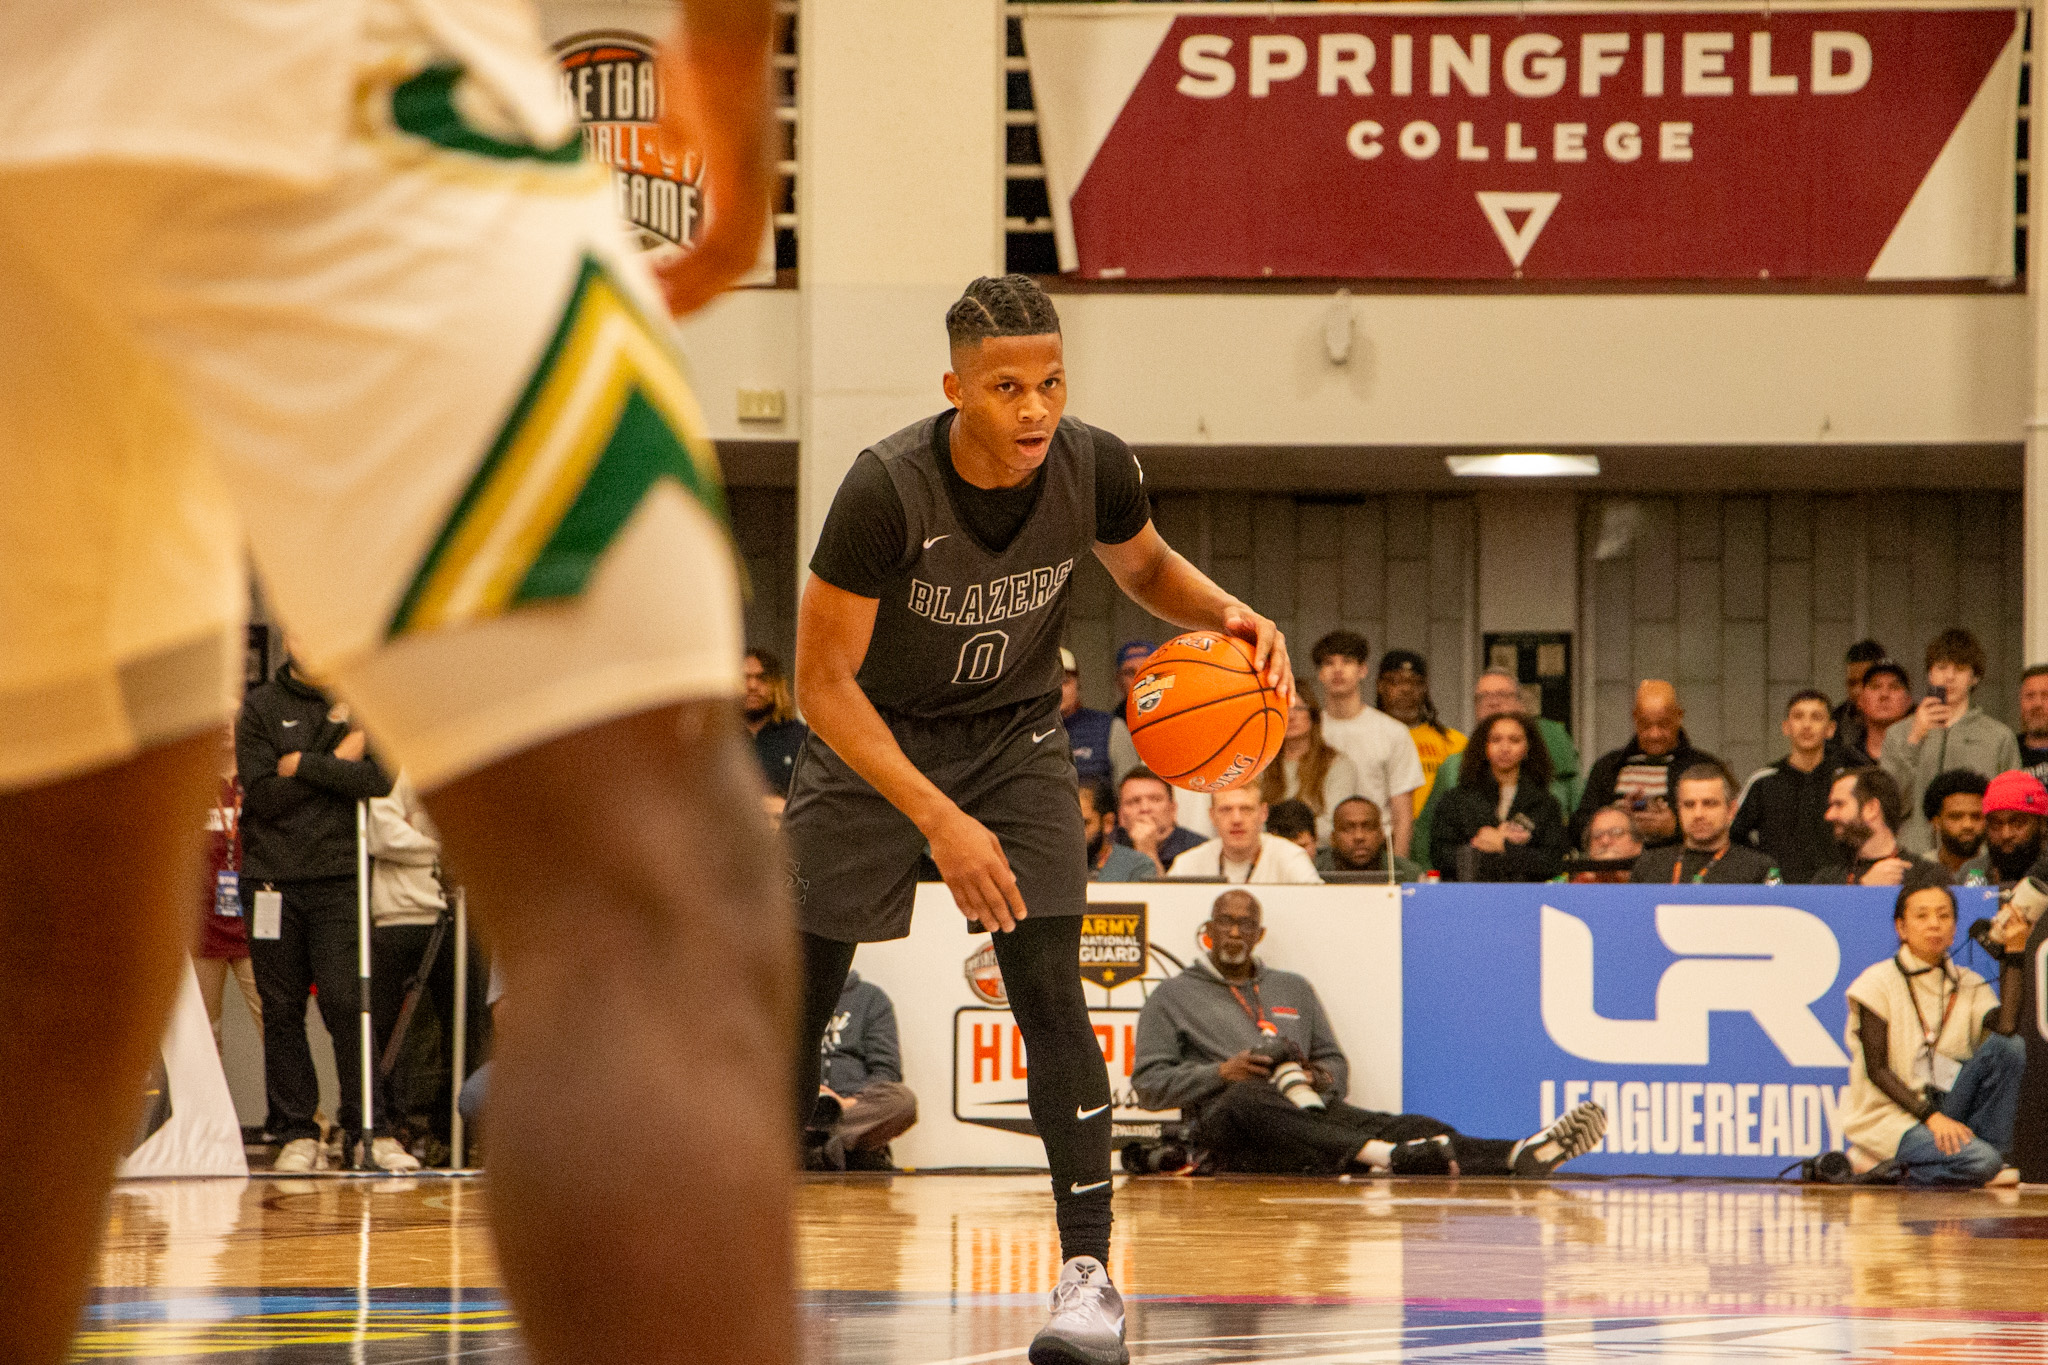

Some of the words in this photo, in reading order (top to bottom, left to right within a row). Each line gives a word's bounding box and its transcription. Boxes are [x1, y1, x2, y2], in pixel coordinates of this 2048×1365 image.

[1177, 31, 1873, 98] SPRINGFIELD
[1346, 120, 1693, 161] COLLEGE
[618, 173, 698, 249] FAME
[909, 558, 1073, 625] BLAZERS
[951, 630, 1009, 684] 0
[1080, 935, 1140, 946] NATIONAL
[1081, 919, 1139, 935] ARMY
[1079, 946, 1141, 962] GUARD
